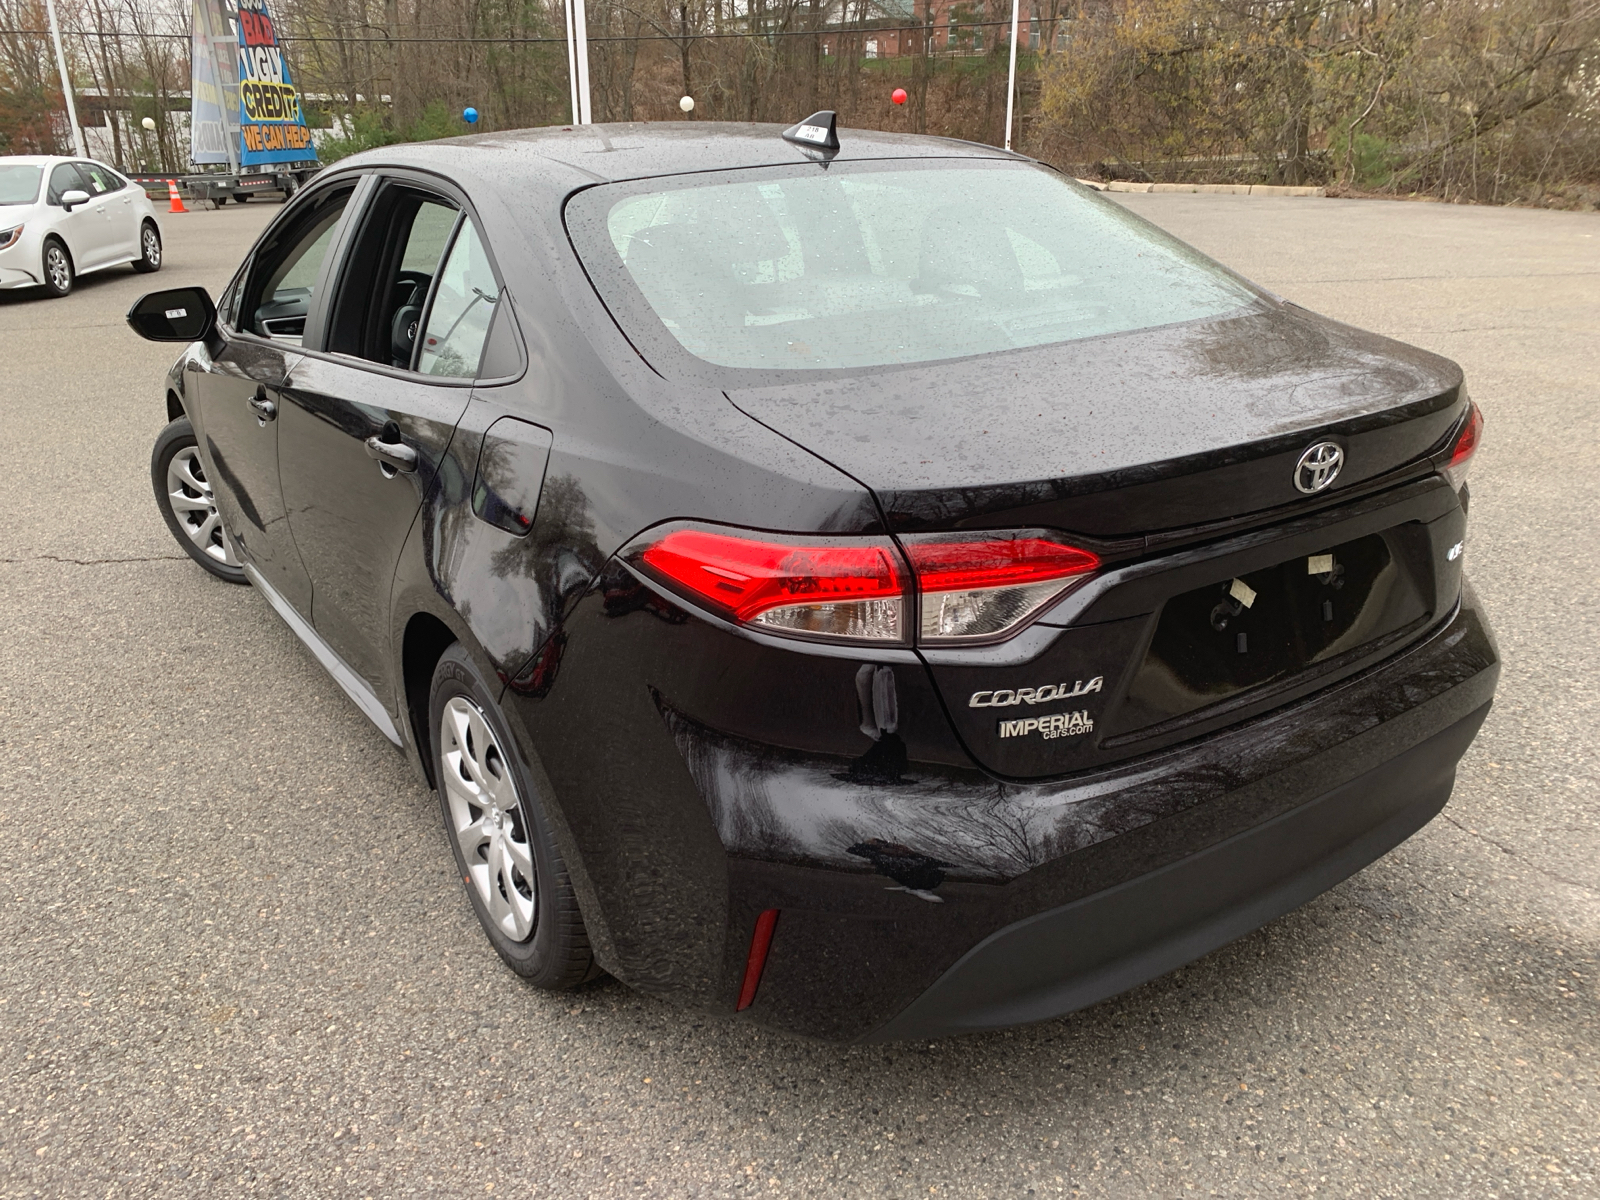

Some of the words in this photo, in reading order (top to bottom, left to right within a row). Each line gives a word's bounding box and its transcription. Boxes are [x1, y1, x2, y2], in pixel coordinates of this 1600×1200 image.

[239, 9, 275, 46] BAD
[240, 46, 284, 84] UGLY
[242, 124, 264, 152] WE
[262, 124, 286, 151] CAN
[969, 675, 1103, 708] COROLLA
[998, 709, 1094, 738] IMPERIAL
[1043, 724, 1093, 740] cars.com
